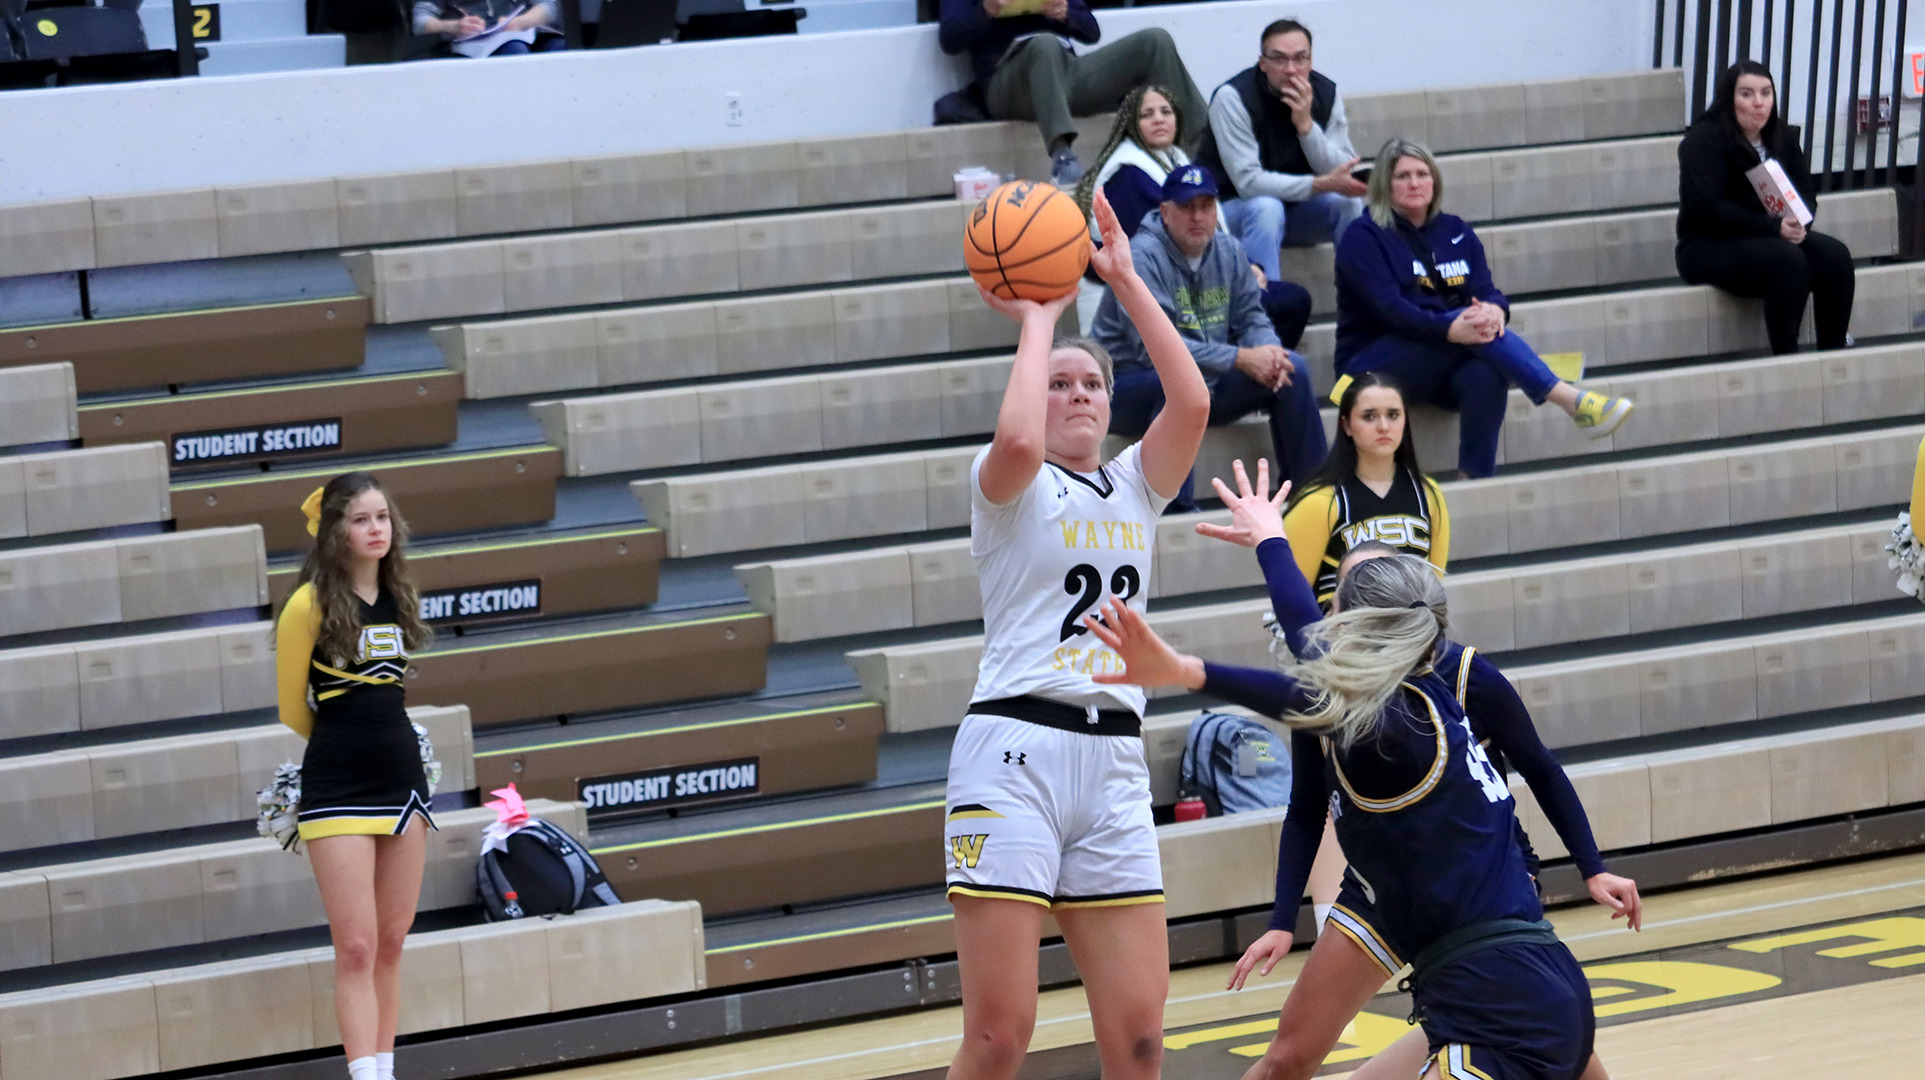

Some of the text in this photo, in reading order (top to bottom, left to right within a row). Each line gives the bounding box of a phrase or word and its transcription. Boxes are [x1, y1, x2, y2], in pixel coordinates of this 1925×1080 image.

[193, 9, 211, 37] 2
[175, 423, 339, 461] STUDENT SECTION
[1060, 520, 1145, 551] WAYNE
[1341, 515, 1430, 551] WSC
[459, 585, 538, 615] SECTION
[1052, 647, 1125, 675] STATE
[582, 764, 756, 809] STUDENT SECTION
[950, 834, 990, 869] W
